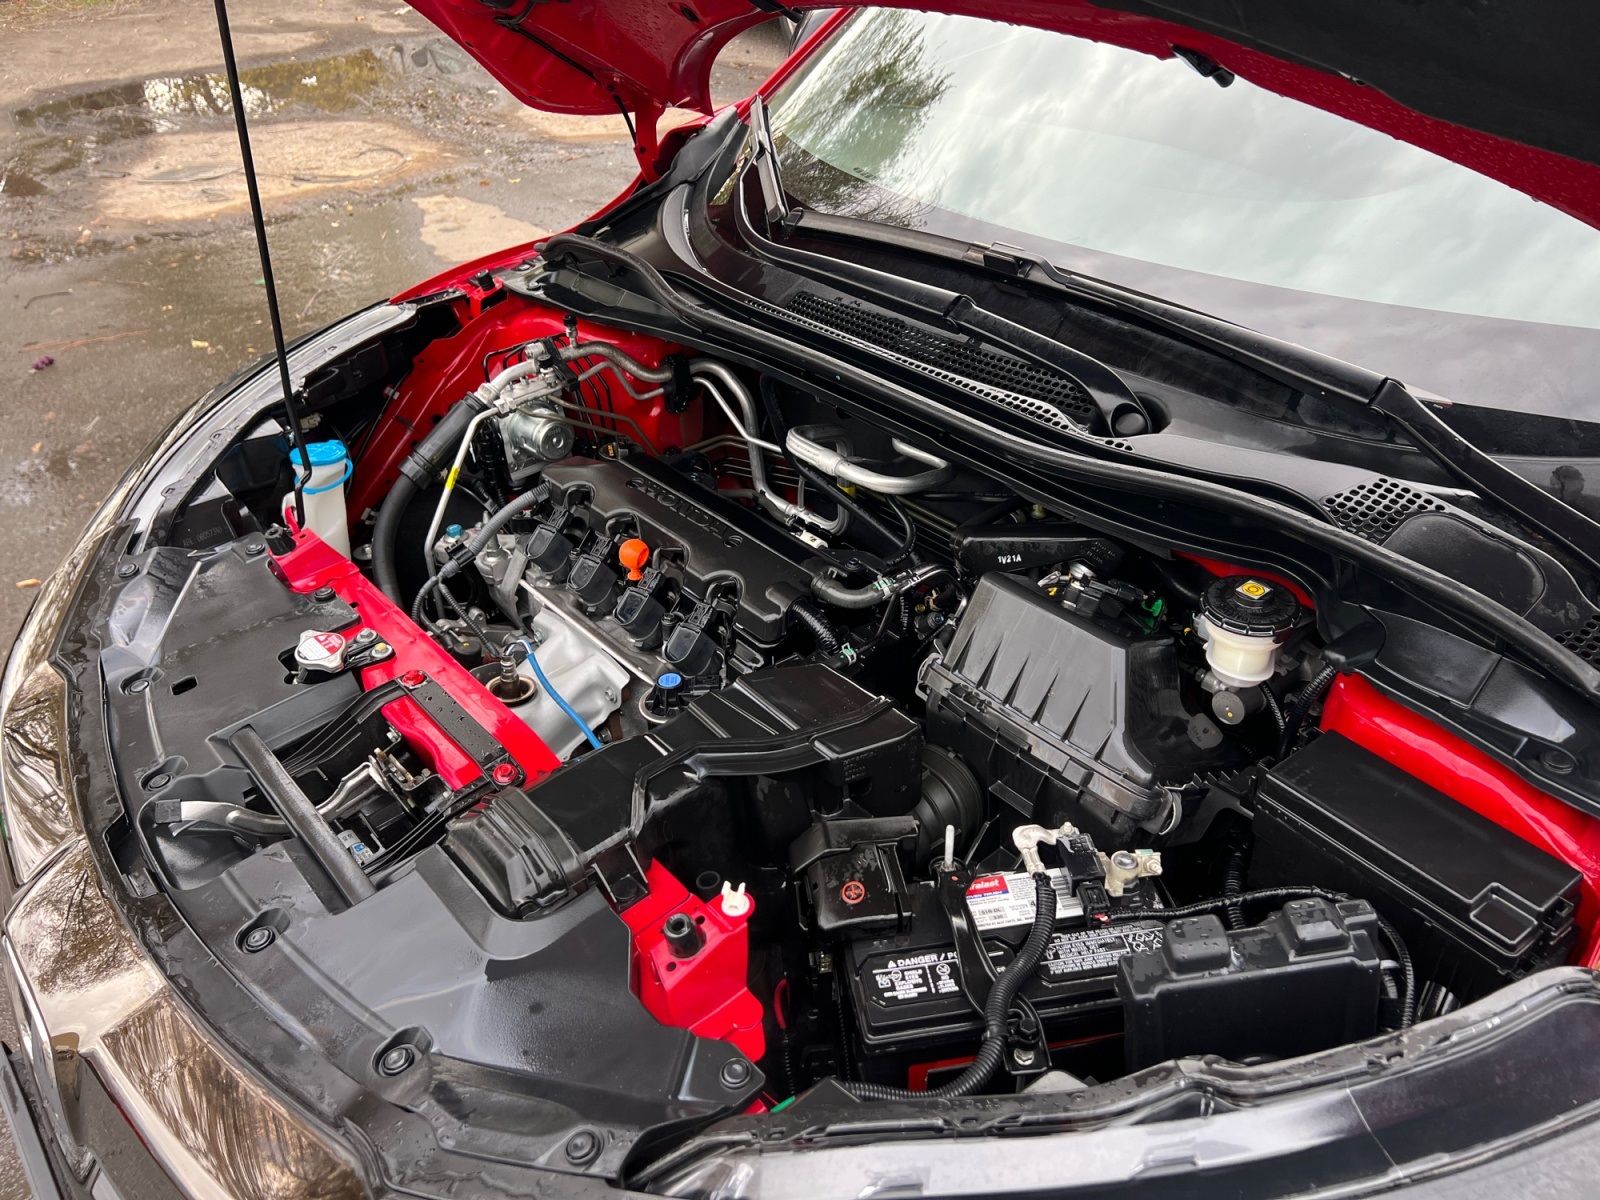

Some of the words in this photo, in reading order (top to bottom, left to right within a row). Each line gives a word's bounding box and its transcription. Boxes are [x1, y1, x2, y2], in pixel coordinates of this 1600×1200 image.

[637, 480, 724, 540] HONDA
[969, 879, 1000, 890] ralast
[897, 953, 938, 967] DANGER
